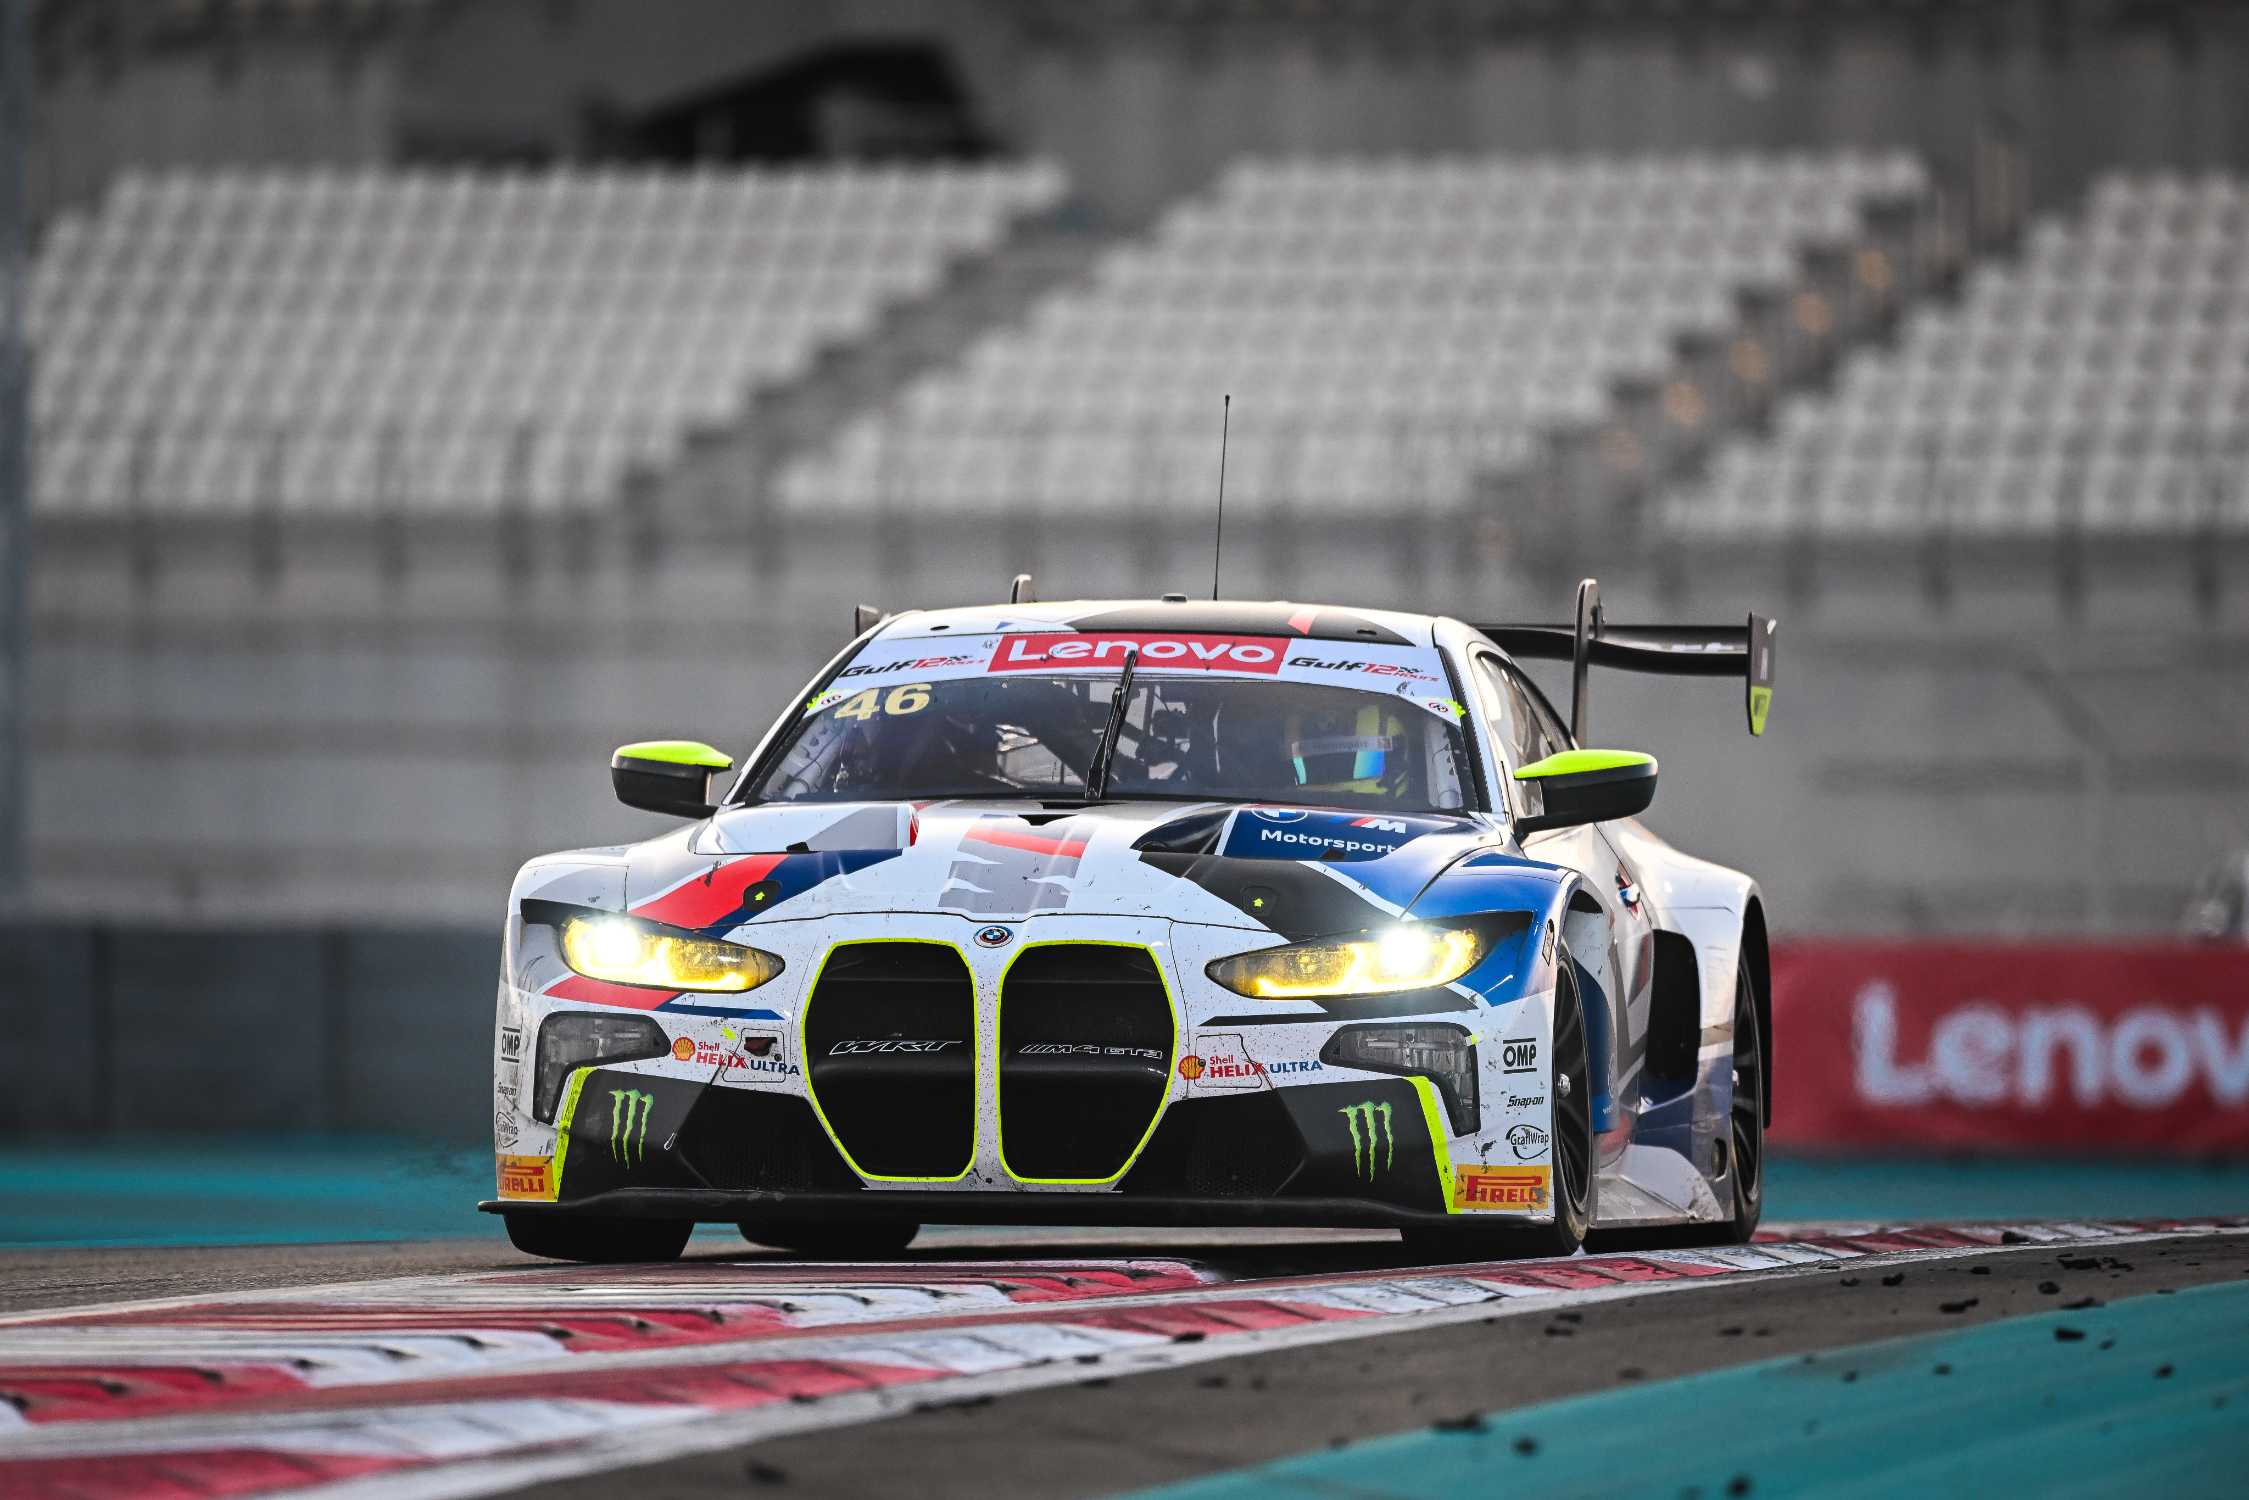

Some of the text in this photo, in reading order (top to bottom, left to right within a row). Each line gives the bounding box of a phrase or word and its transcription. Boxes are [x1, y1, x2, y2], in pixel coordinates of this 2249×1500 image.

[1007, 638, 1275, 664] Lenovo
[834, 682, 933, 721] 46
[1261, 829, 1397, 854] Motorsport
[501, 1032, 521, 1057] OMP
[697, 1041, 721, 1051] Shell
[828, 1040, 964, 1056] WRT
[1104, 1046, 1163, 1060] GT3
[696, 1051, 801, 1076] HELIX ULTRA
[1209, 1055, 1235, 1065] Shell
[1502, 1044, 1538, 1068] OMP
[1210, 1060, 1324, 1079] HELIX ULTRA
[1506, 1095, 1545, 1109] Snap-on
